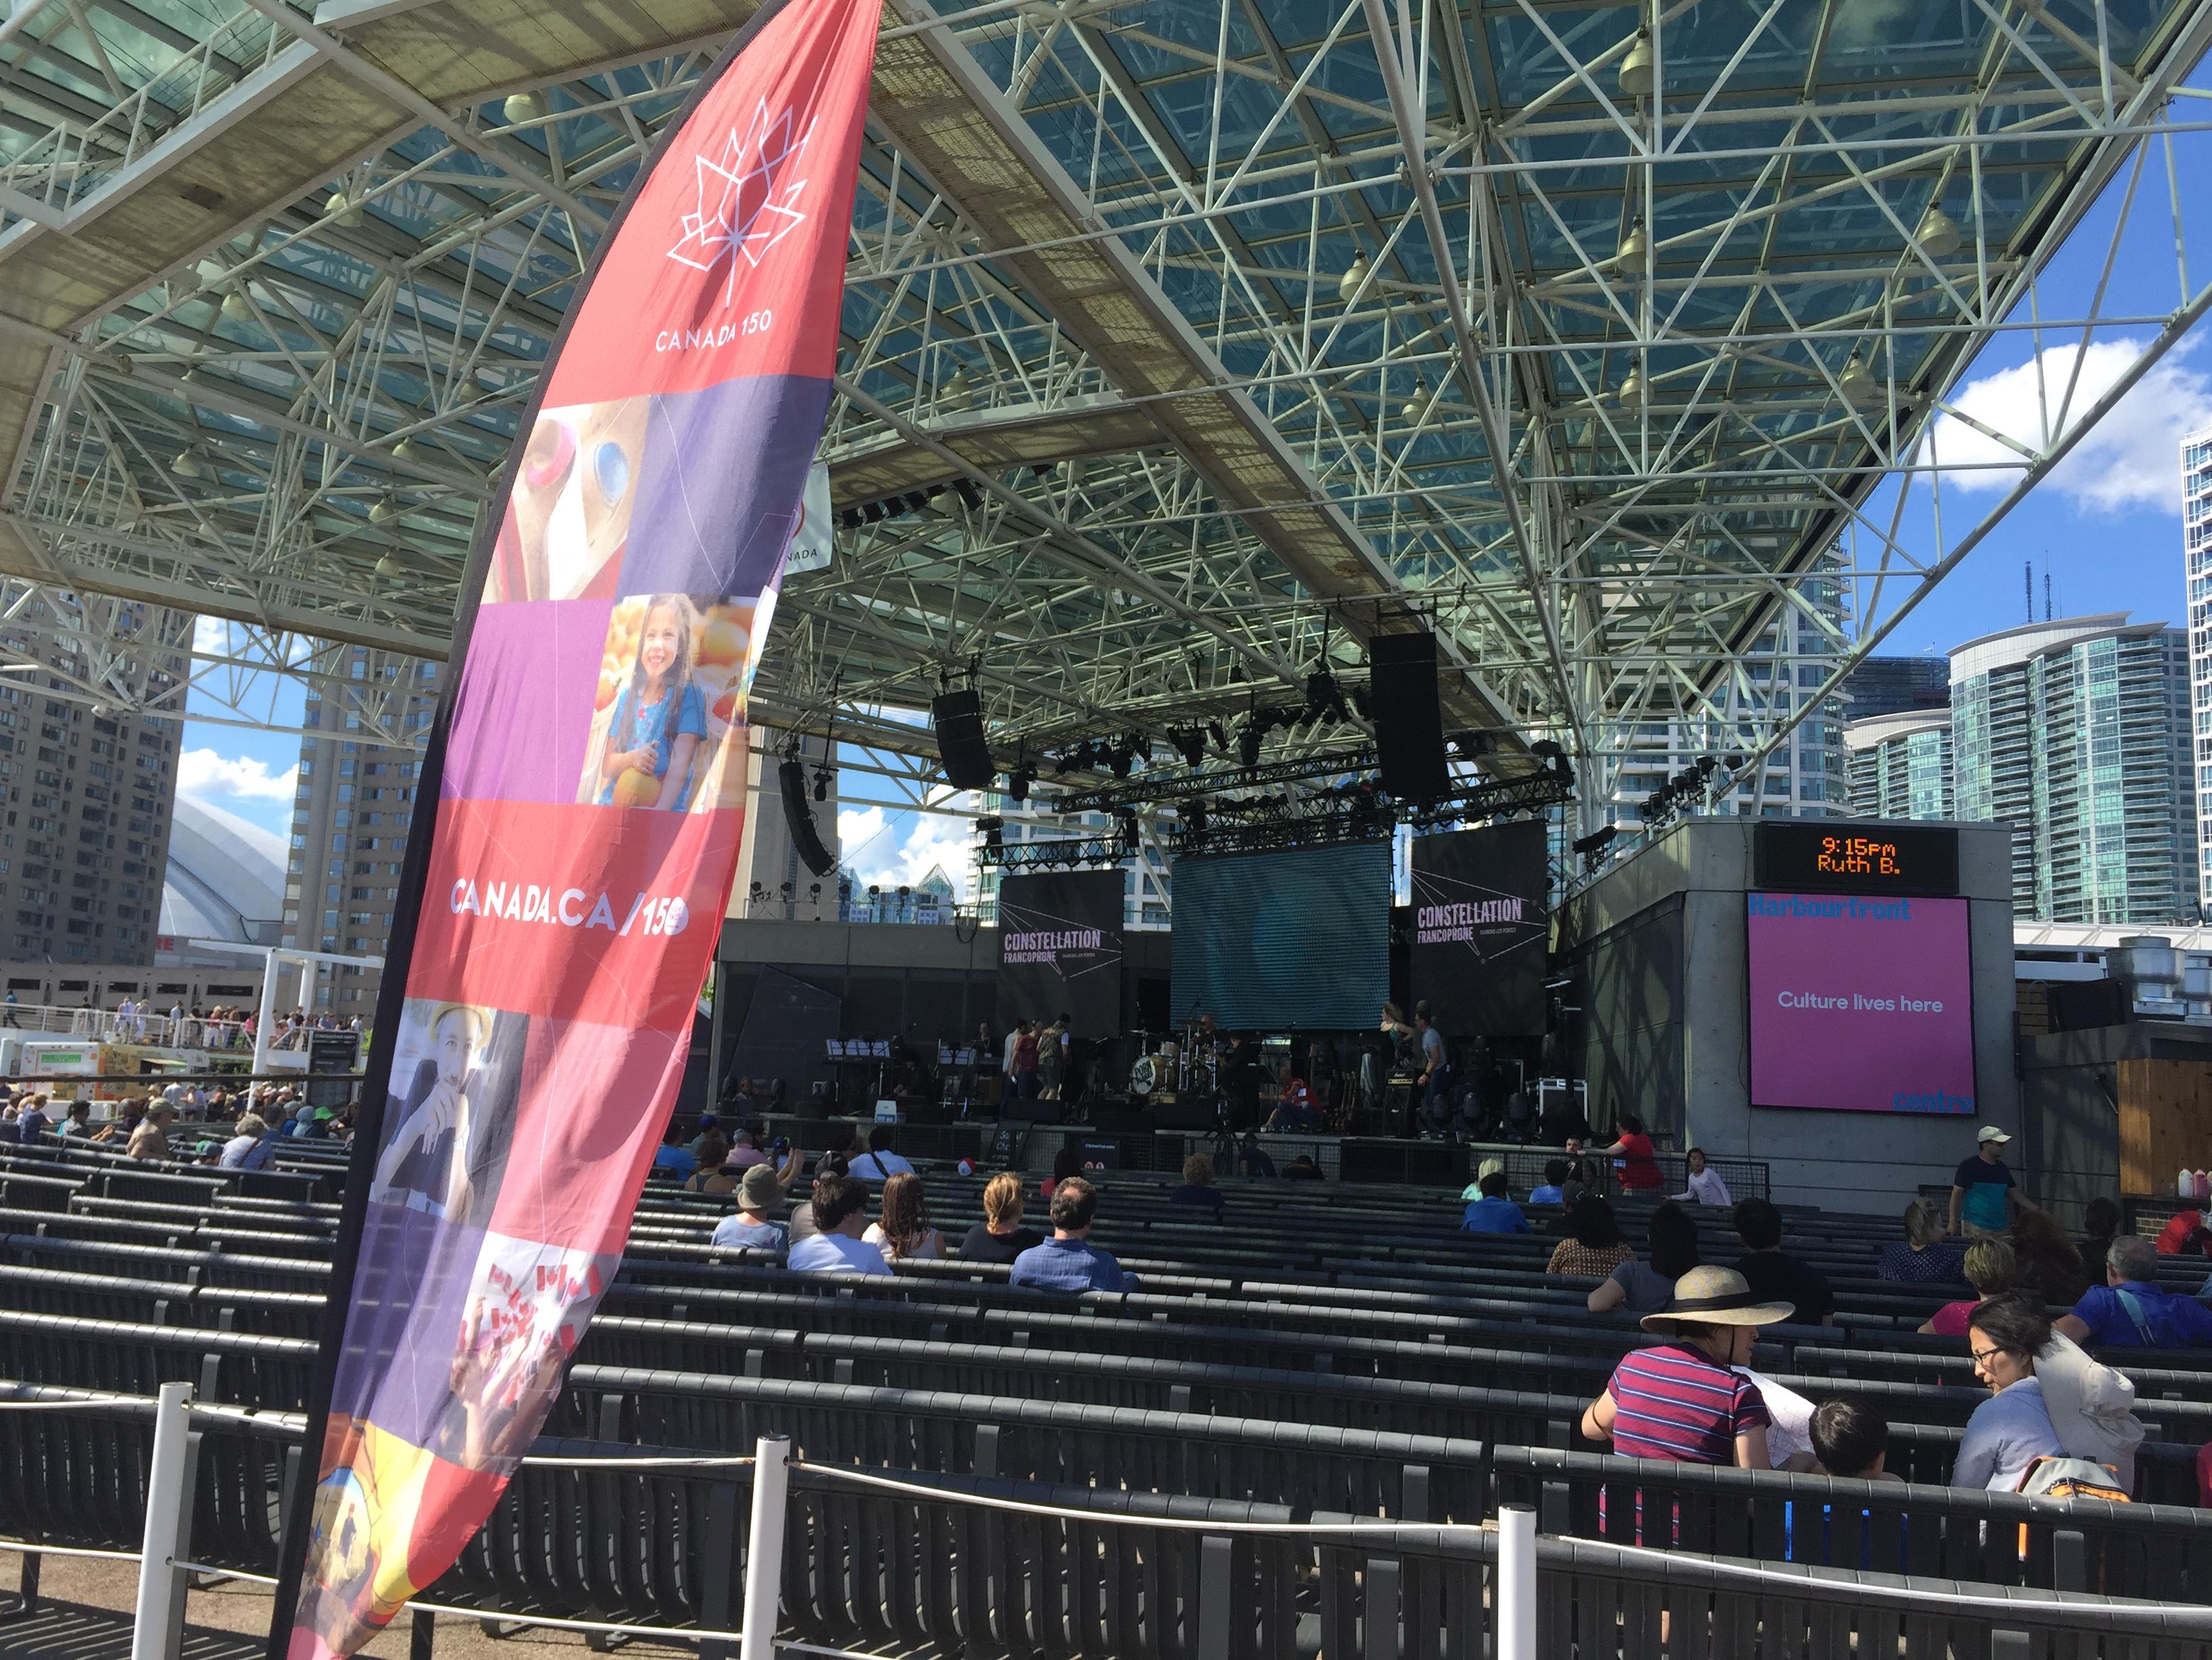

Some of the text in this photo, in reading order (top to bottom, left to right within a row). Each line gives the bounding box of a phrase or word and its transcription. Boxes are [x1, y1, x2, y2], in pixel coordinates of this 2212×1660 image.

[656, 309, 773, 352] CANADA 150
[786, 548, 818, 561] NADA
[1817, 854, 1901, 875] Ruth B.
[1418, 898, 1522, 928] CONSTELLATION
[1749, 894, 1912, 921] Harbourfront
[1005, 930, 1101, 951] CONSTELLATION
[1417, 927, 1474, 944] FRANCOPHONE
[1004, 951, 1056, 963] FRANCOPHONE
[1777, 991, 1944, 1013] Culture lives here
[1893, 1090, 1973, 1113] centre
